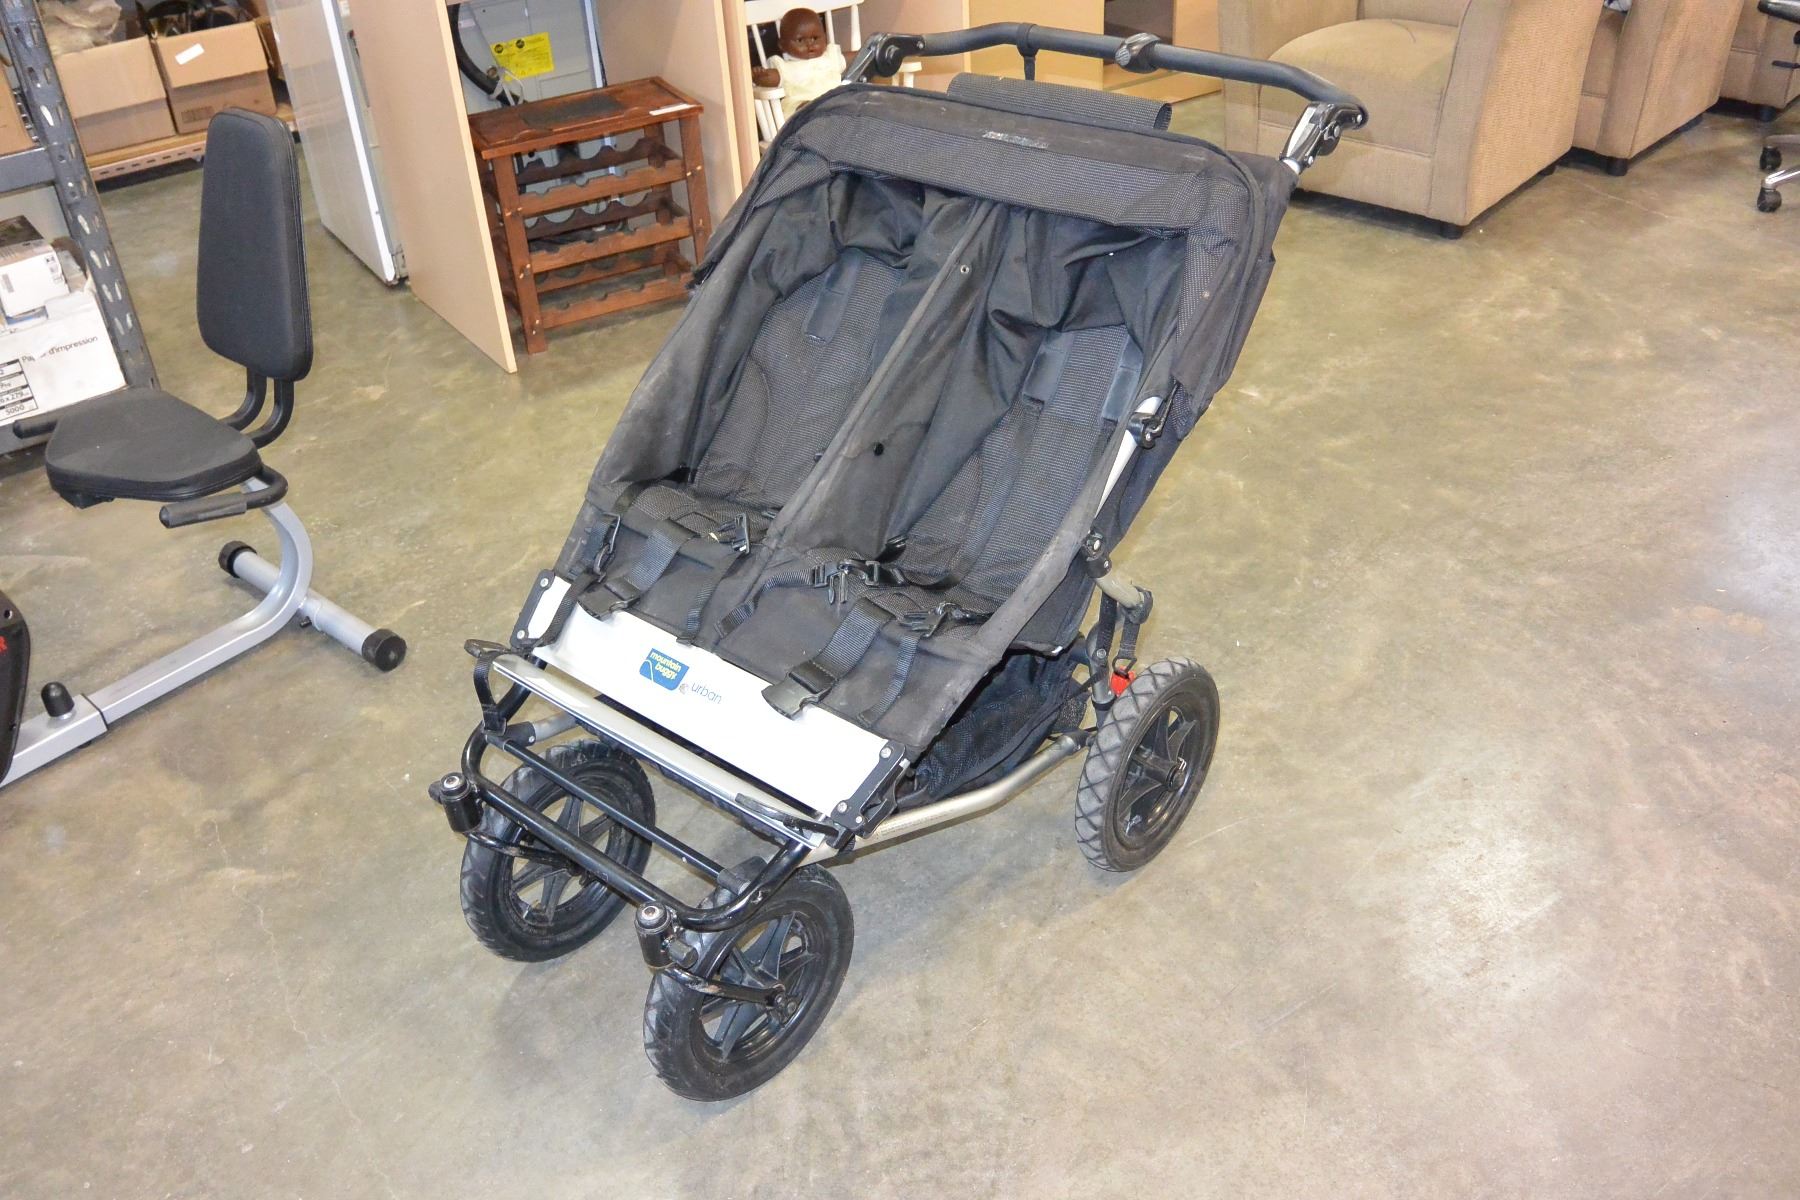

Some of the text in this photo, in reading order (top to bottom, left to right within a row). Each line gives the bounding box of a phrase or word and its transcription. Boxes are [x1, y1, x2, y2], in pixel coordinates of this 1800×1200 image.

[48, 336, 98, 355] d'impression
[5, 404, 25, 415] 5000
[650, 652, 682, 673] mountain
[655, 662, 678, 680] buggy
[691, 682, 722, 704] urban
